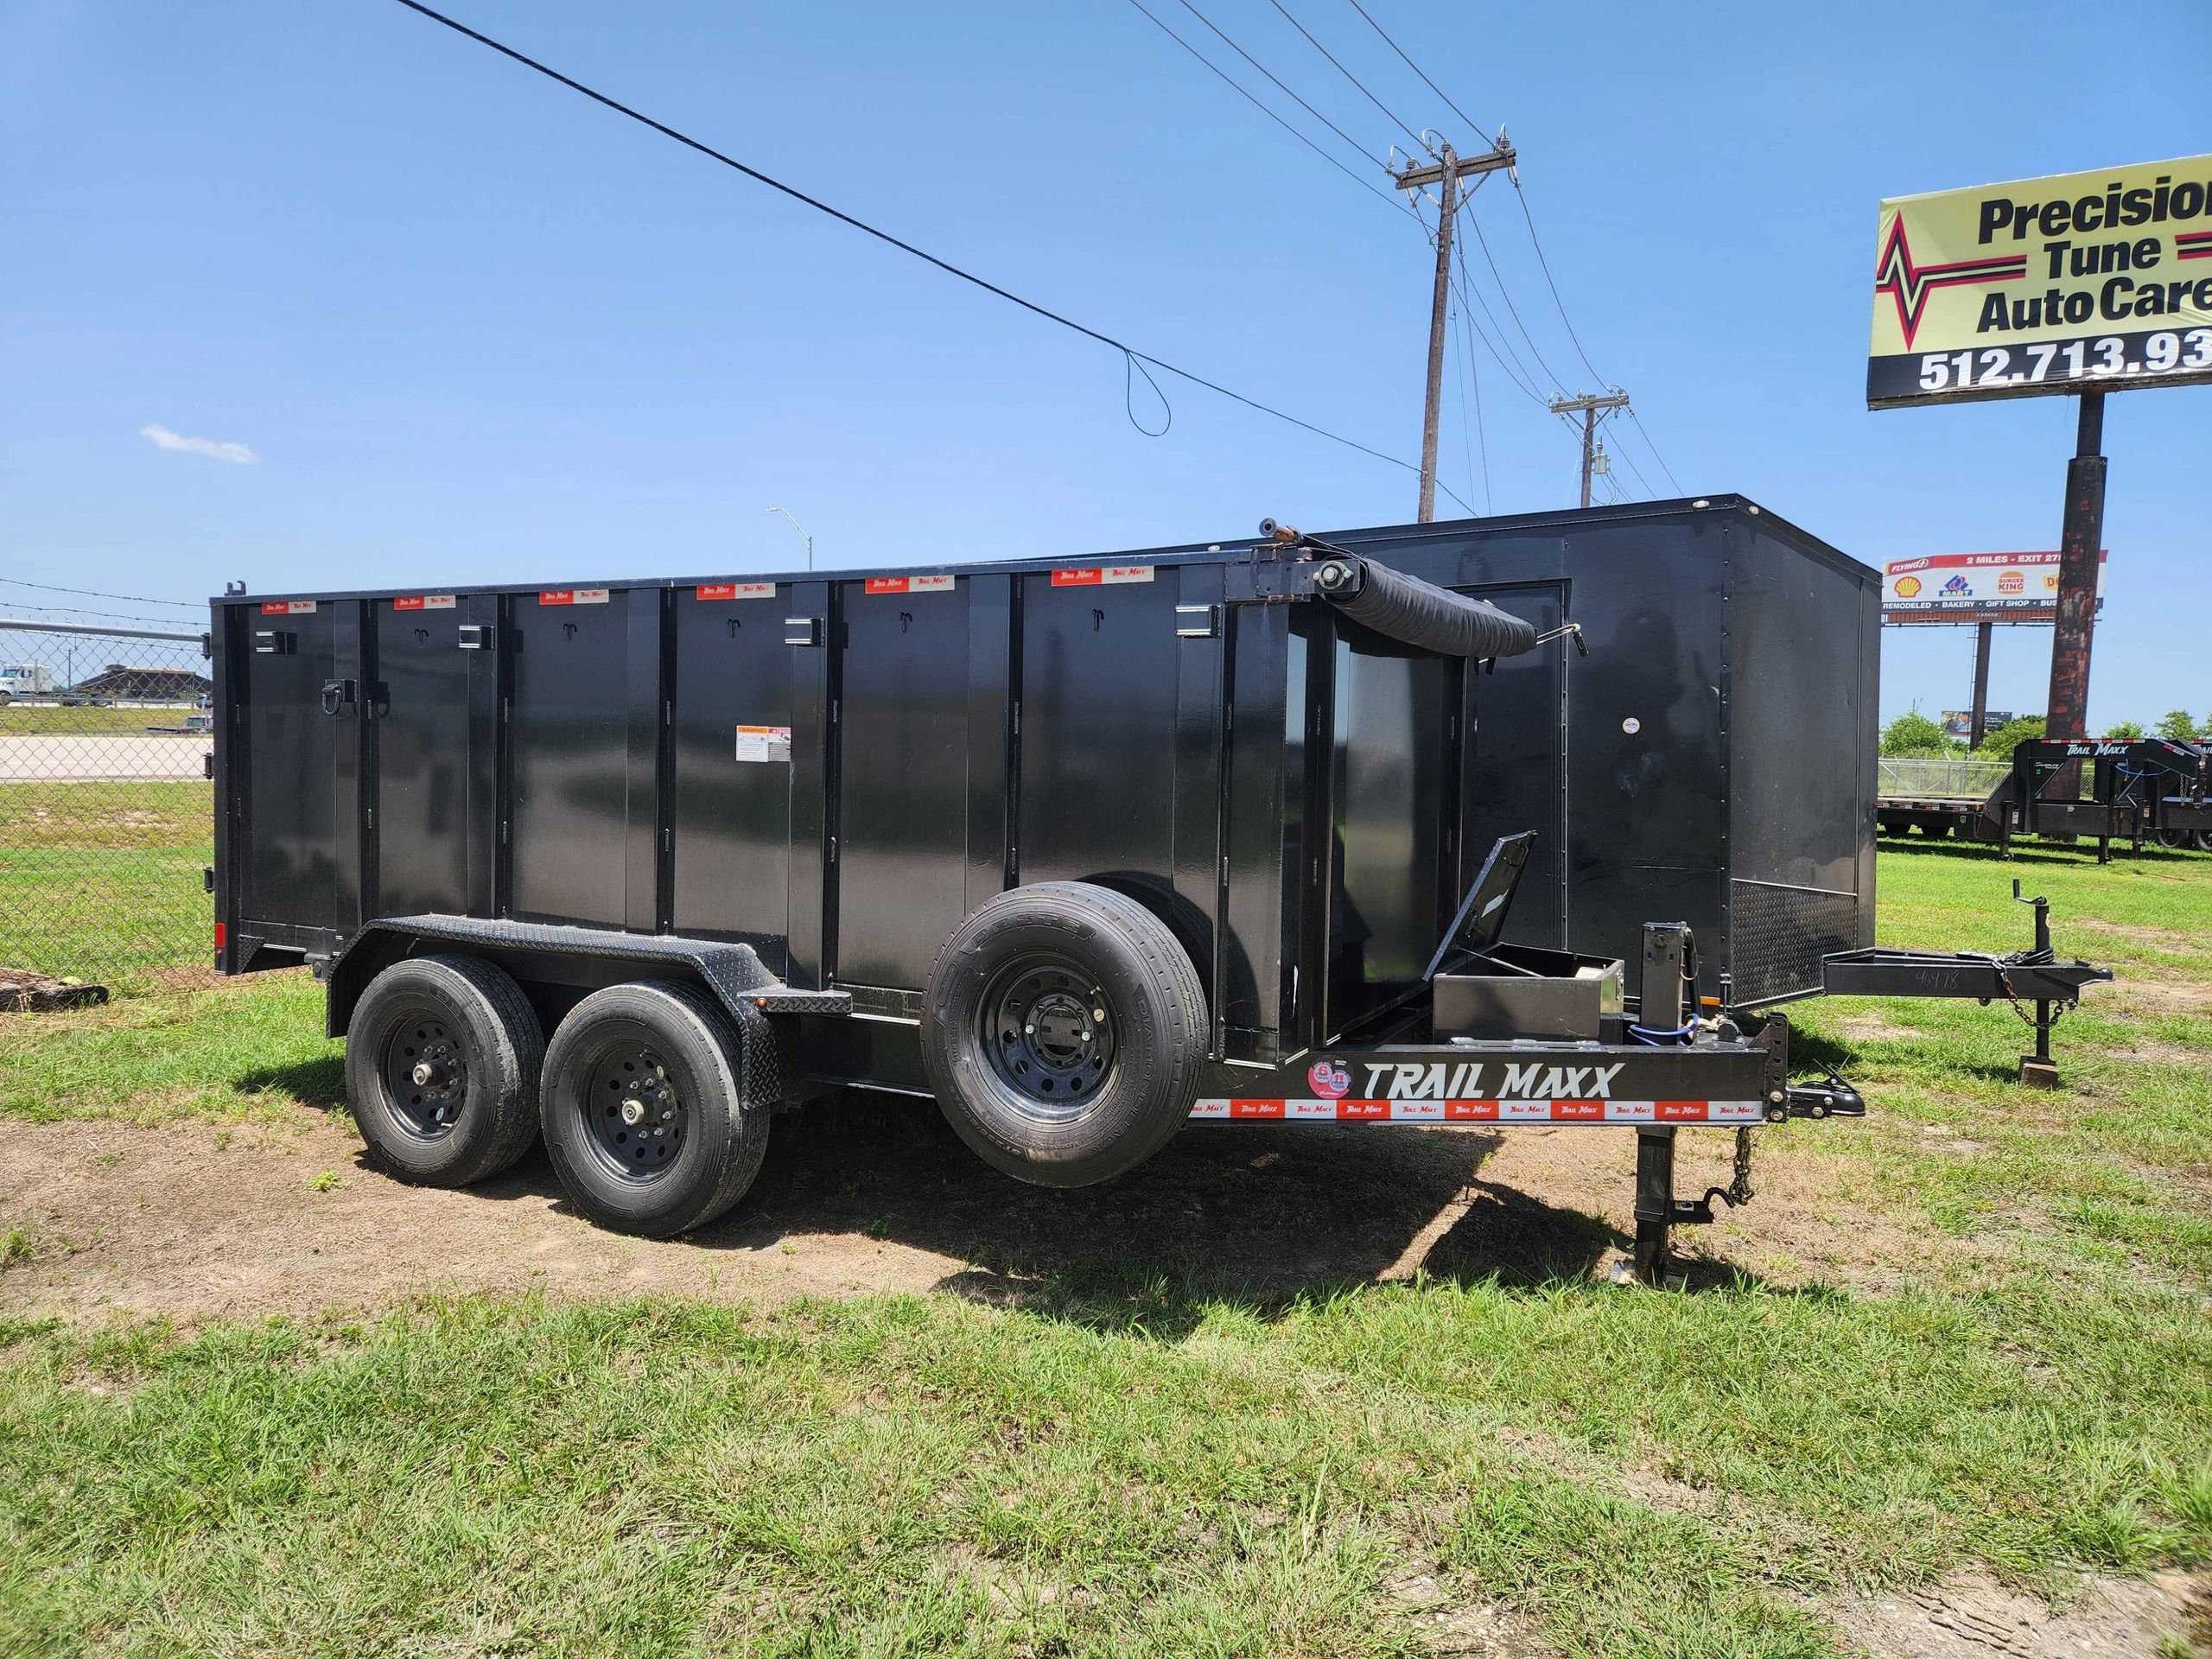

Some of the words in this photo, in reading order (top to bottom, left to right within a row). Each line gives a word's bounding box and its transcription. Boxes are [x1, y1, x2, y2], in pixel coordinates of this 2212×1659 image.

[1978, 175, 2212, 245] Precisio
[2044, 238, 2162, 280] Tune
[1919, 329, 2212, 390] 512.713.93
[1891, 563, 1918, 572] FLYING
[2066, 744, 2090, 756] TRAIL
[2094, 743, 2129, 756] MAXX
[1363, 1063, 1484, 1099] TRAIL
[1495, 1063, 1626, 1099] MAXX
[1258, 1104, 1278, 1113] MAXX
[1313, 1104, 1332, 1113] MAXX
[1363, 1104, 1383, 1114] MAXX
[1419, 1105, 1439, 1114] MAXX
[1454, 1105, 1470, 1114] TRAIL
[1472, 1105, 1492, 1114] MAXX
[1527, 1105, 1547, 1114] MAXX
[1579, 1105, 1598, 1114] MAXX
